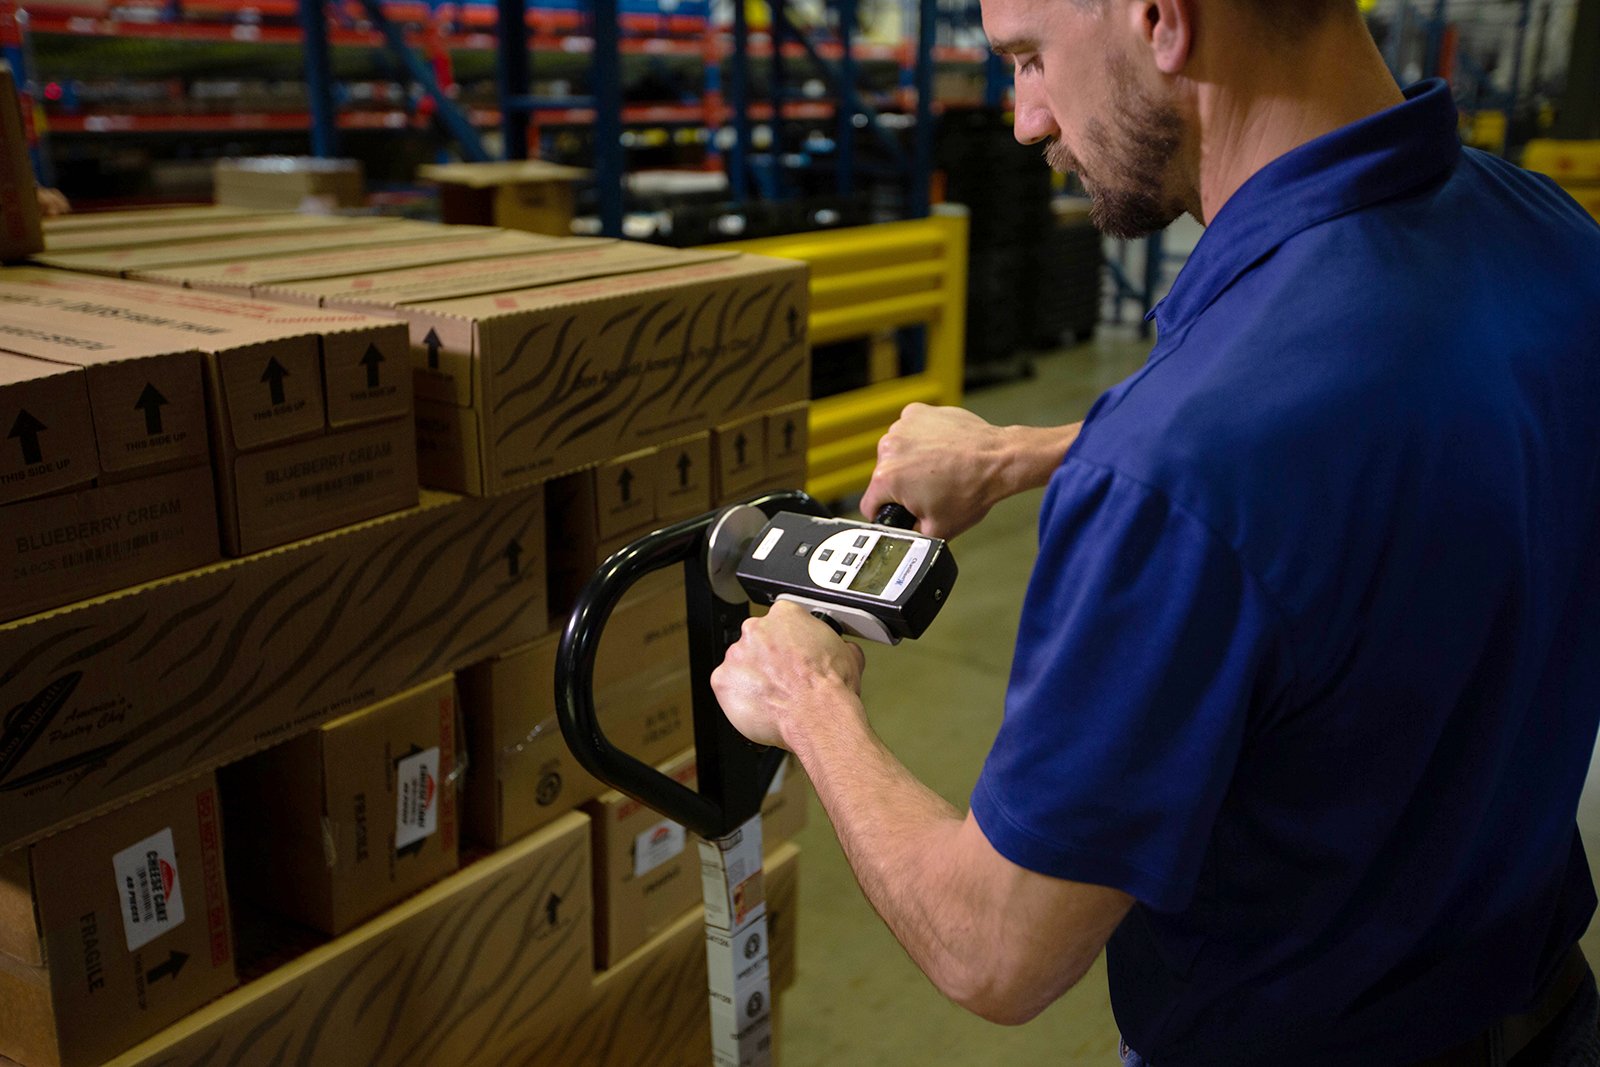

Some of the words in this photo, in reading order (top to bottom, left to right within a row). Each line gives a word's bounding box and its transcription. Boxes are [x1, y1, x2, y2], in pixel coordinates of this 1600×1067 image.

[126, 440, 147, 452] THIS
[149, 435, 170, 447] SIDE
[173, 431, 187, 442] UP
[0, 469, 26, 484] THIS
[28, 461, 53, 477] SIDE
[55, 457, 71, 471] UP
[264, 453, 346, 485] BLUEBERRY
[350, 441, 392, 464] CREAM
[16, 513, 122, 554] BLUEBERRY
[126, 499, 183, 526] CREAM
[146, 850, 163, 892] CHEESE
[128, 890, 140, 923] PIECES
[153, 893, 168, 922] CAKE
[80, 911, 104, 994] FRAGILE
